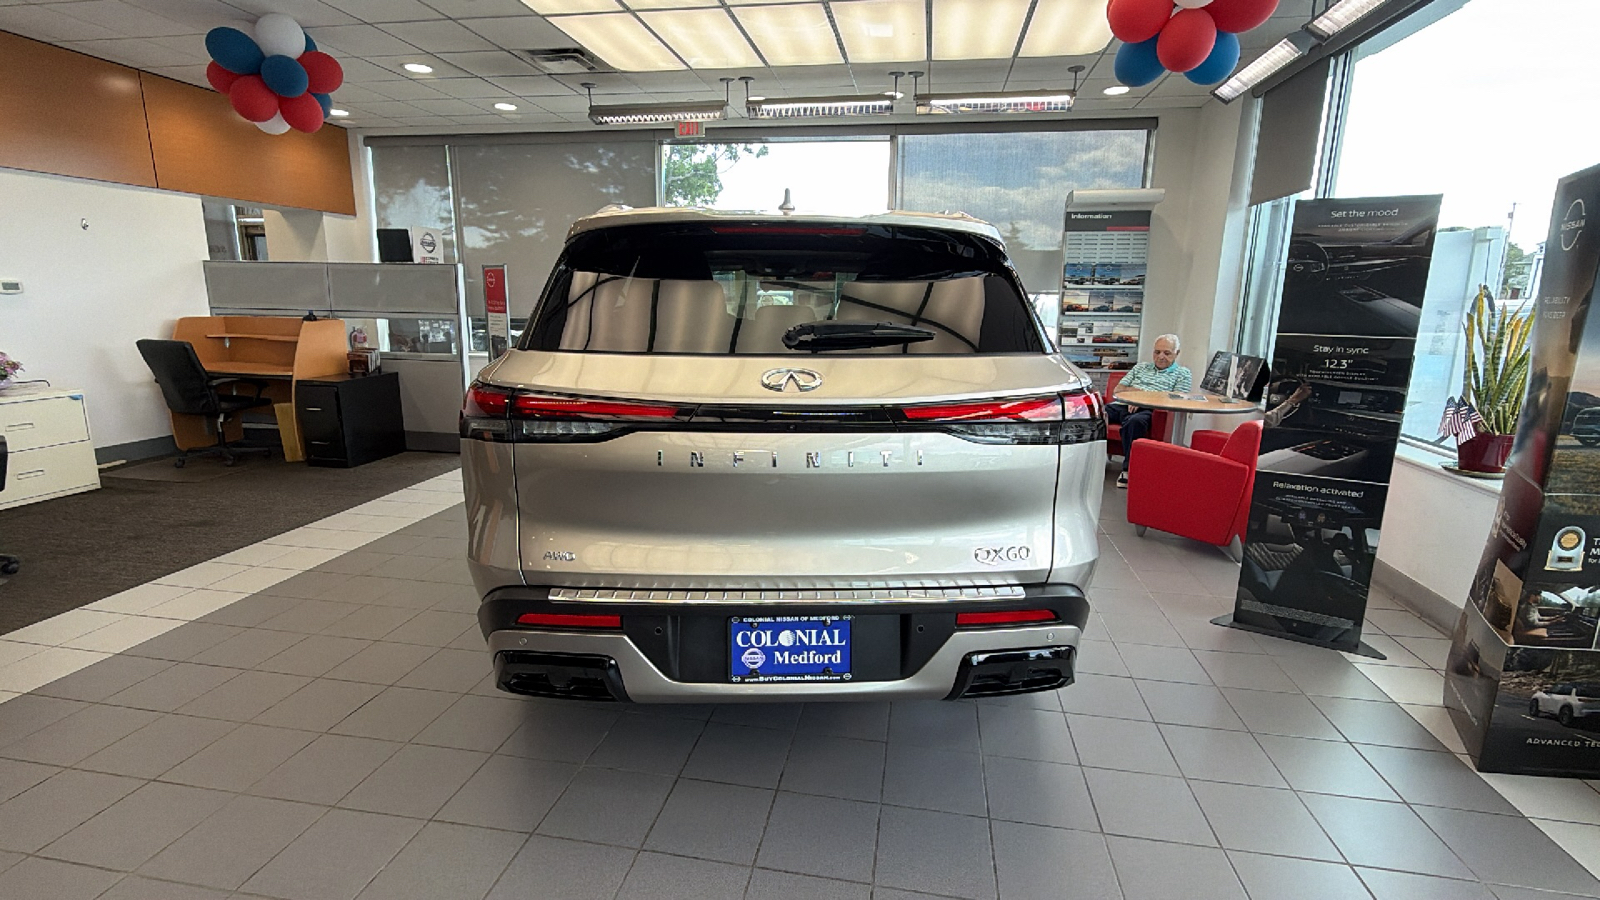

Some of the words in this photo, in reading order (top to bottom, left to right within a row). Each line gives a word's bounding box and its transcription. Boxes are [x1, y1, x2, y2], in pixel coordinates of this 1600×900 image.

[1331, 210, 1346, 218] Set
[1349, 209, 1365, 218] the
[1367, 208, 1398, 217] mood
[1313, 344, 1334, 354] Stay
[1335, 345, 1344, 353] in
[1346, 347, 1369, 355] sync
[657, 449, 923, 468] INFINITI
[1272, 481, 1319, 493] Relaxation
[1320, 487, 1364, 498] activated
[543, 551, 576, 562] AWD
[974, 546, 1030, 566] QX60
[736, 629, 846, 647] COLONIAL
[773, 650, 841, 665] Medford
[1526, 737, 1580, 747] ADVANCED
